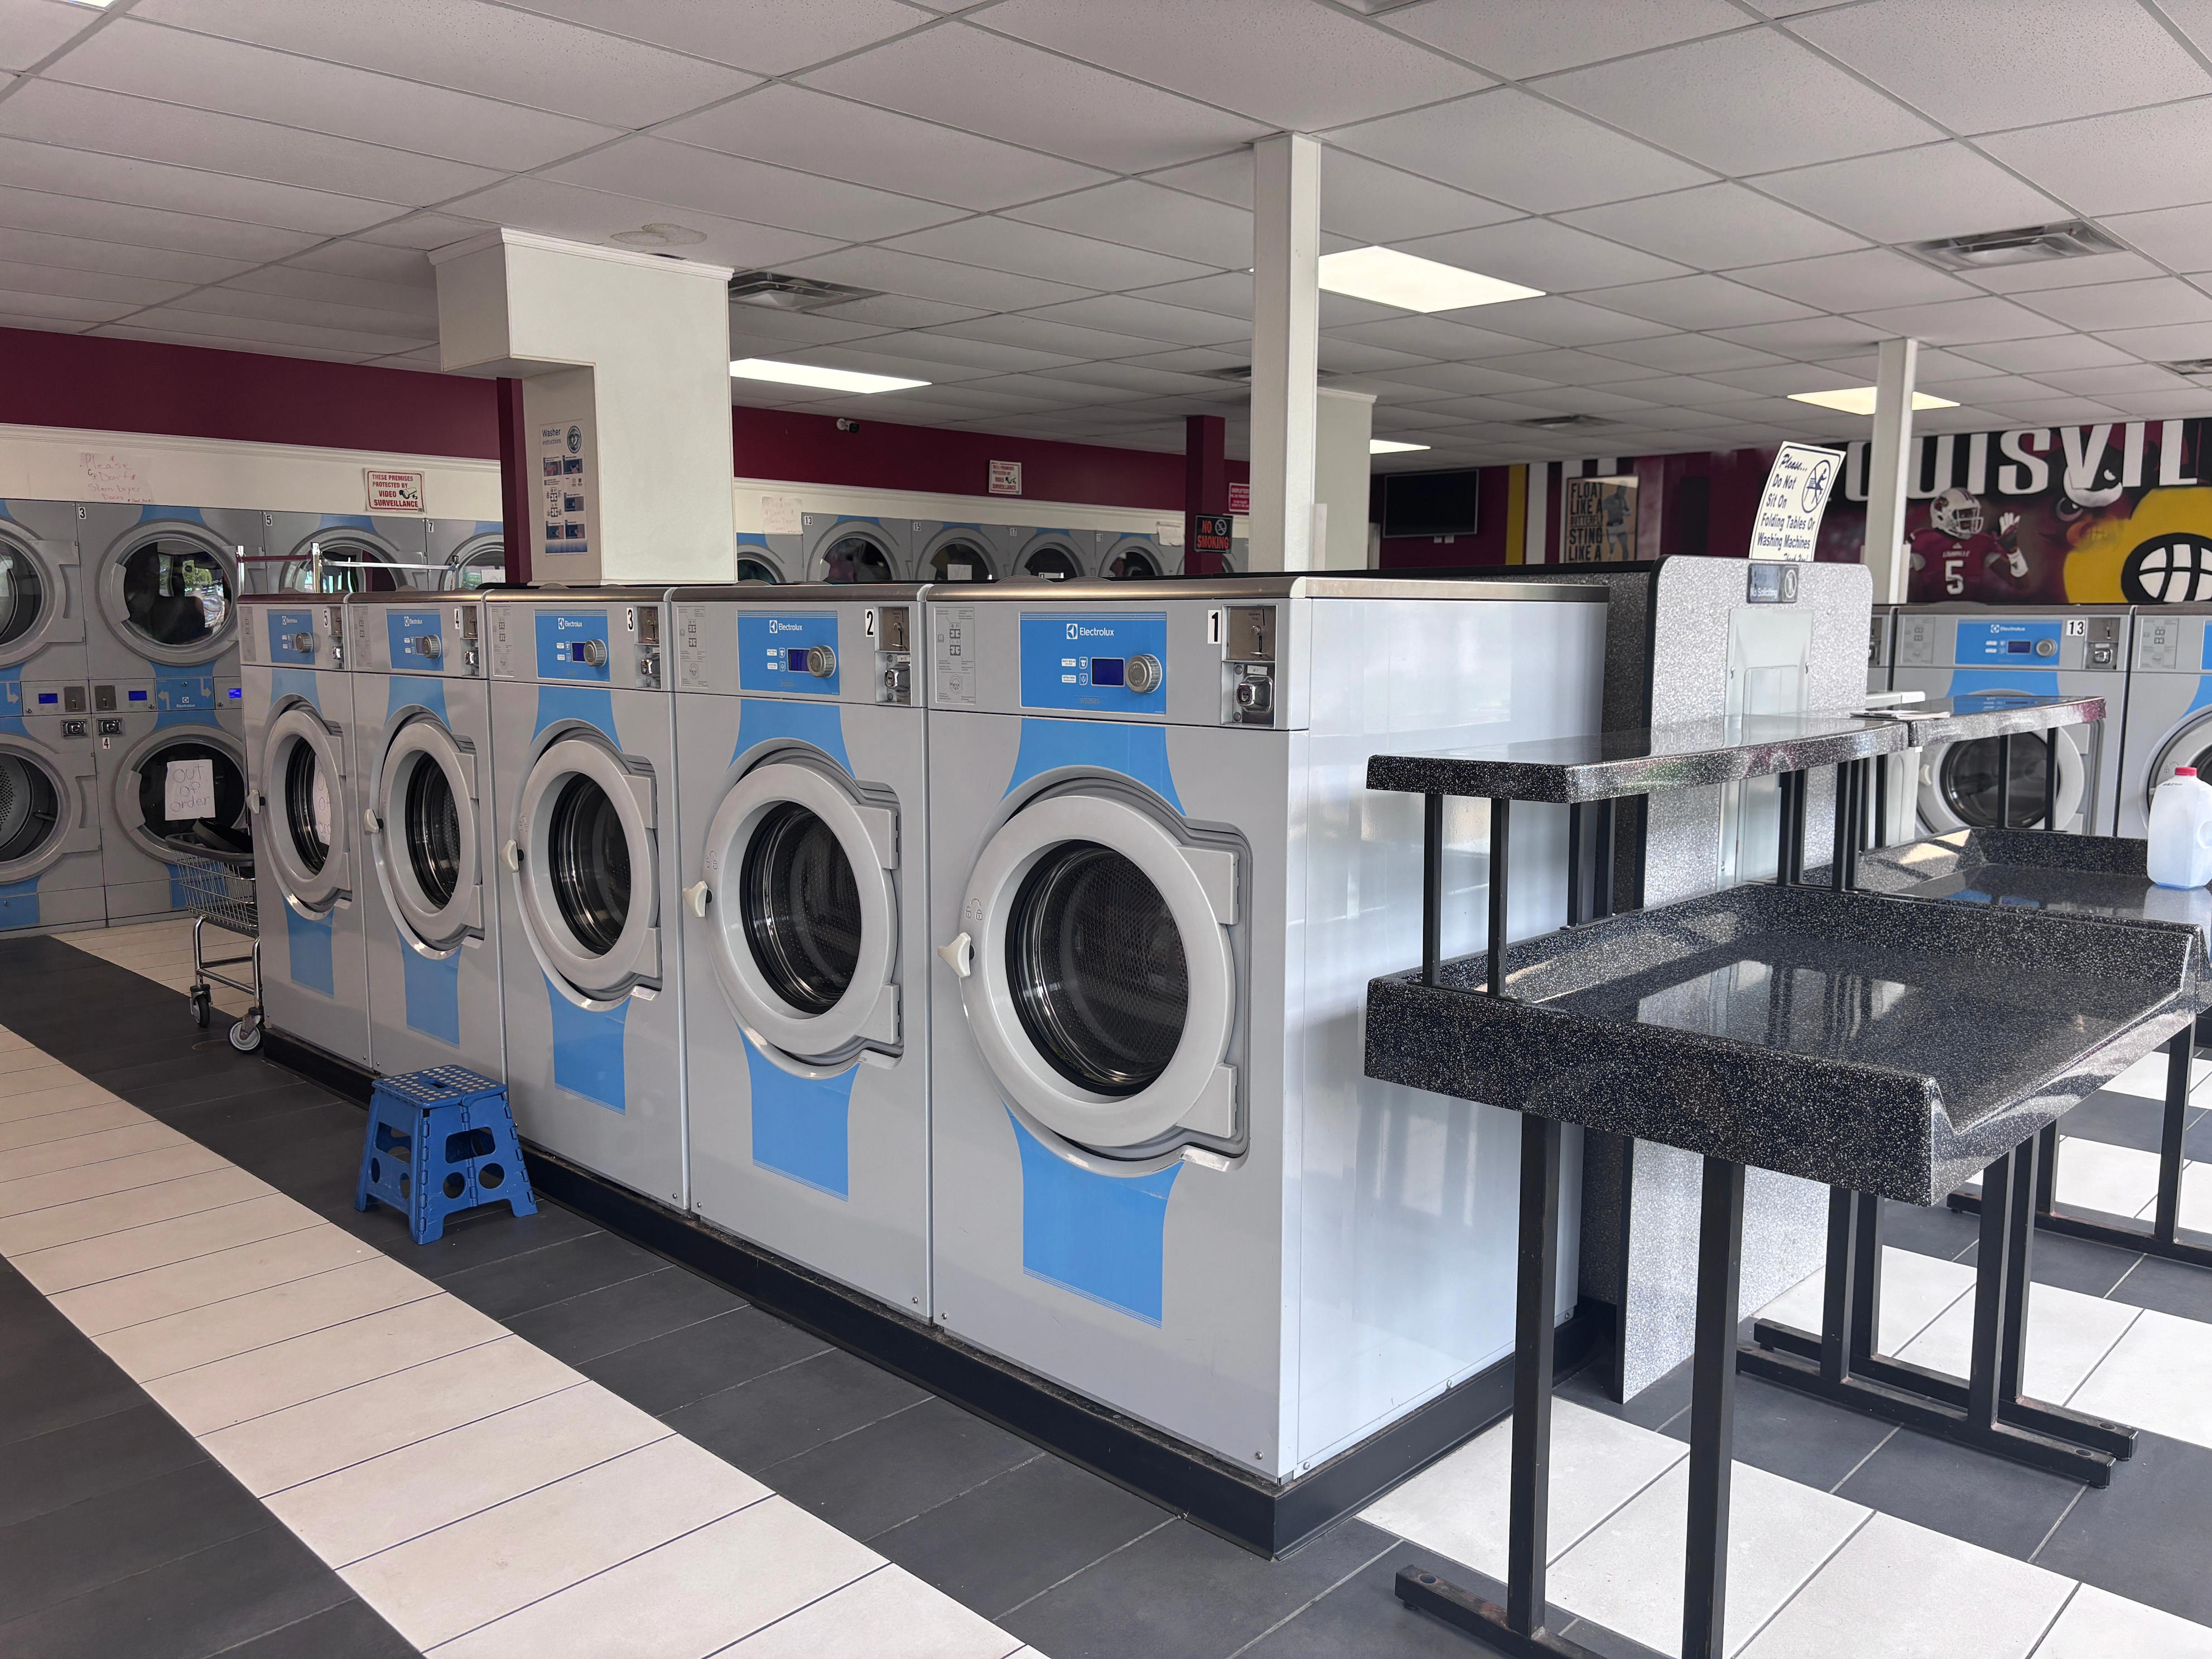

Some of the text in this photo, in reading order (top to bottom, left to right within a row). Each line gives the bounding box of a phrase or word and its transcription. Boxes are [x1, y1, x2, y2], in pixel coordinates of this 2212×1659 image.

[542, 428, 561, 437] Washer
[85, 454, 132, 469] Please
[1779, 454, 1807, 471] Please...
[1772, 474, 1796, 490] Do Not
[1571, 483, 1602, 498] FLOAT
[374, 499, 418, 508] SURVEILLANCE
[1570, 498, 1603, 514] LIKE A
[1766, 493, 1787, 508] Sit On
[80, 508, 85, 518] 3
[267, 515, 271, 525] 5
[429, 523, 433, 532] 7
[1202, 520, 1212, 533] NO
[1761, 513, 1815, 531] Folding Tables Or
[1197, 535, 1230, 549] SMOKING
[1570, 527, 1602, 544] STING
[1757, 532, 1810, 551] Washing Machines
[1569, 545, 1602, 561] LIKE A
[1945, 560, 1964, 595] 5
[1757, 587, 1778, 599] Soliciting
[324, 610, 327, 626] 5
[455, 610, 459, 628] 4
[628, 609, 633, 630] 3
[867, 611, 874, 635] 2
[1080, 628, 1115, 636] Electrolux
[1212, 612, 1218, 642] 1
[2069, 621, 2084, 635] 13
[104, 738, 109, 748] 4
[173, 763, 205, 783] OUT
[170, 795, 210, 812] order
